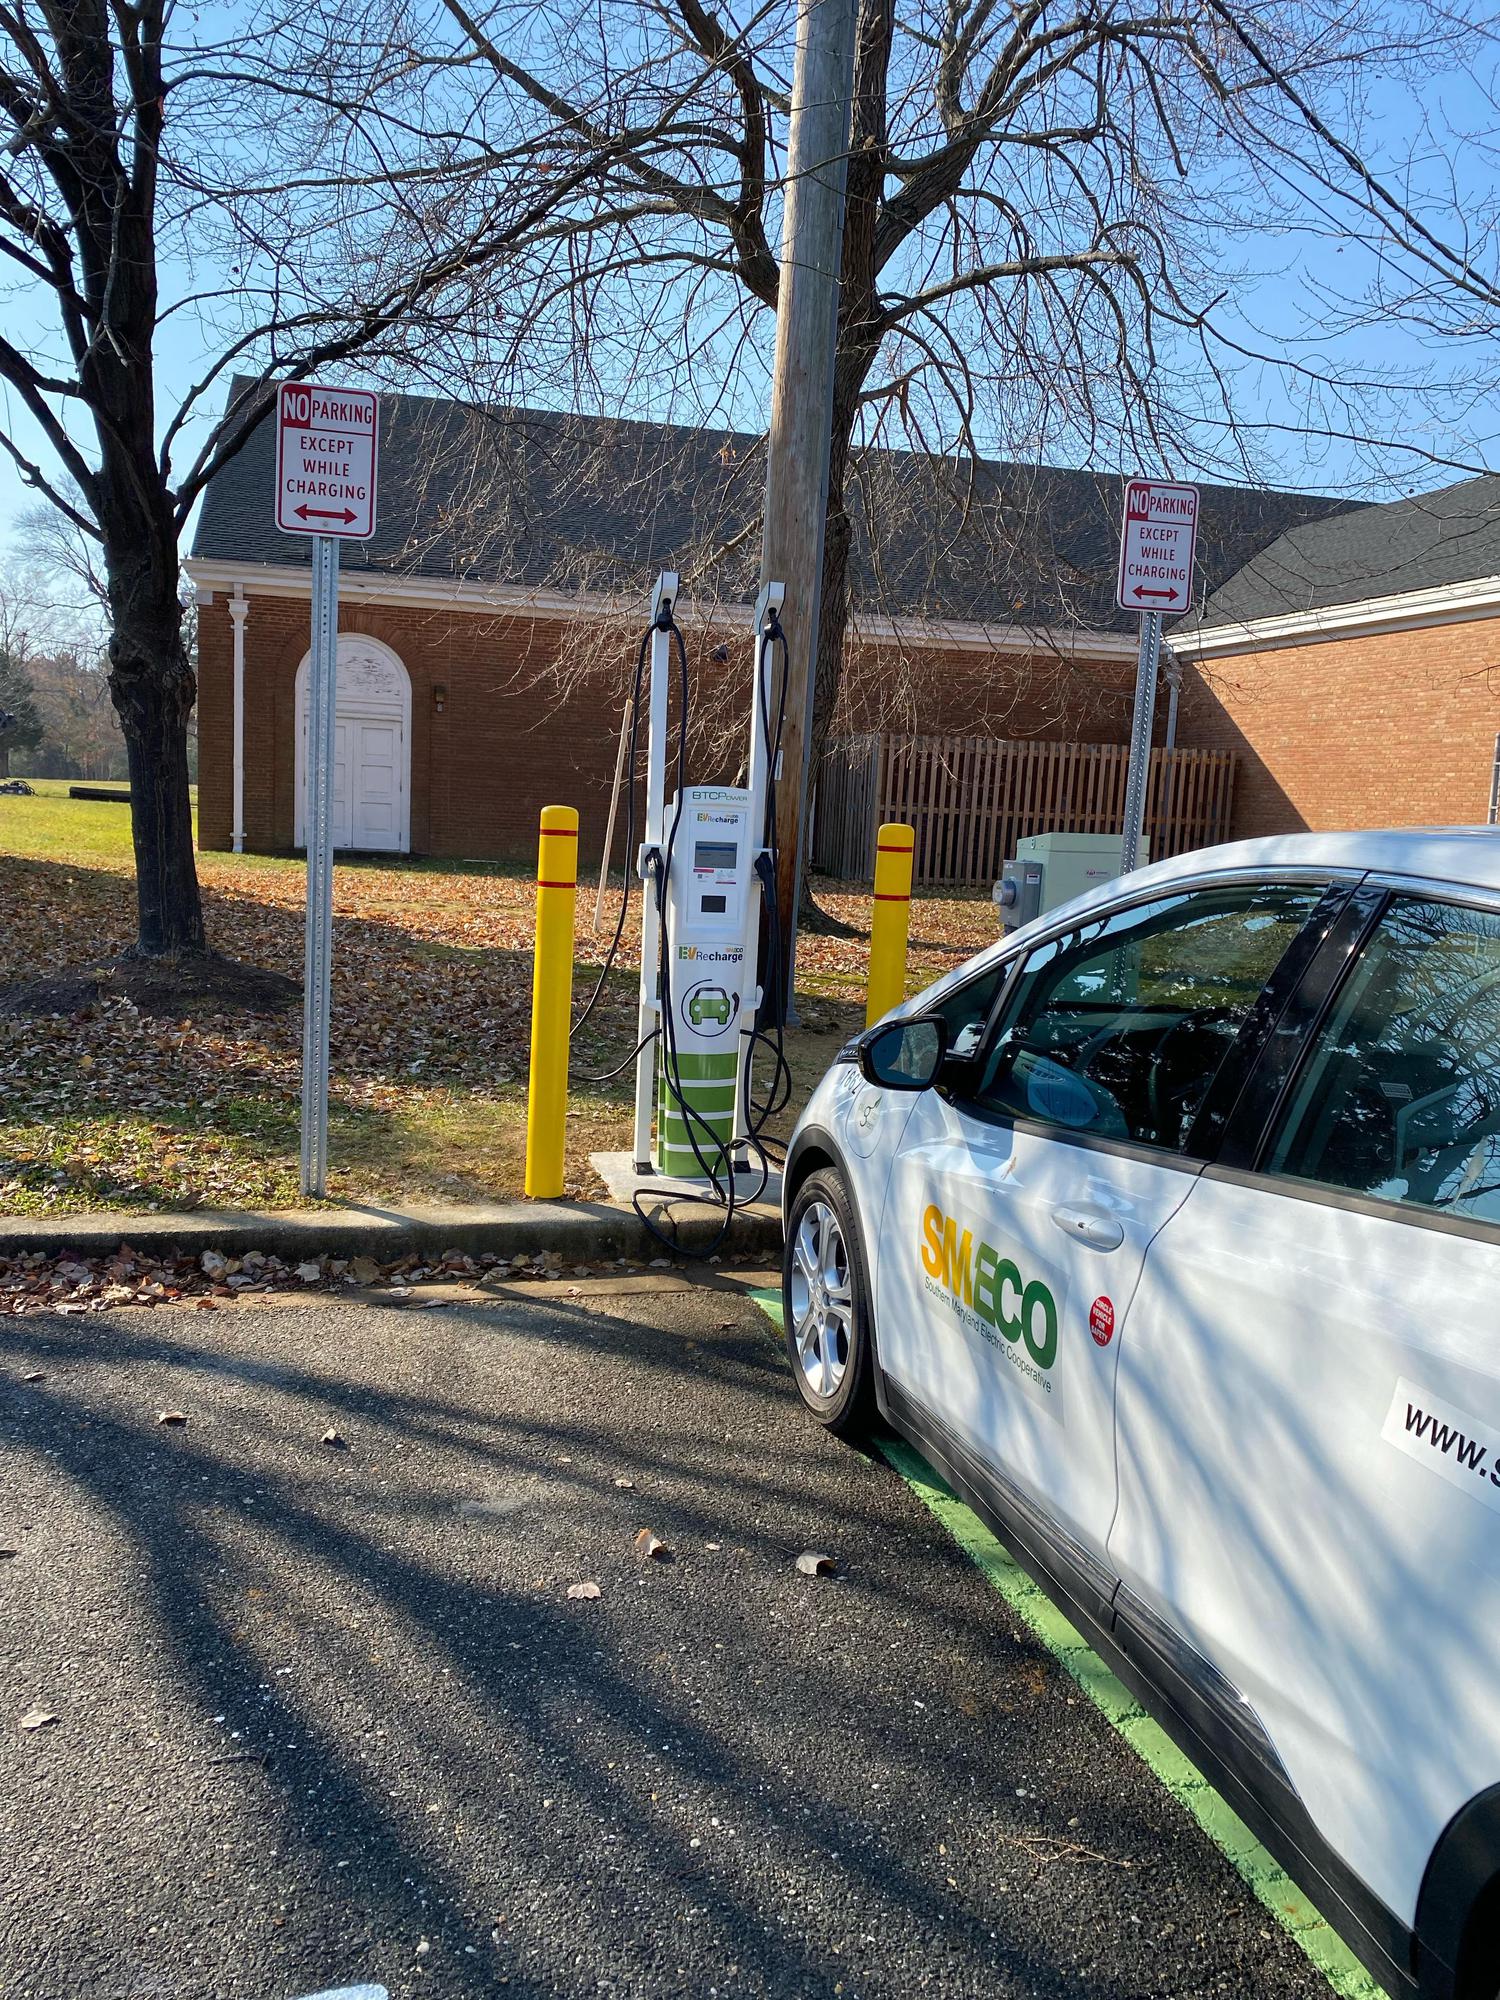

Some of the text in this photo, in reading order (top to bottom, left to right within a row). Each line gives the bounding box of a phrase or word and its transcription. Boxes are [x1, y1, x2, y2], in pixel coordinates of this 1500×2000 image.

[283, 392, 373, 424] NO PARKING
[301, 436, 354, 455] EXCEPT
[303, 458, 350, 477] WHILE
[286, 478, 366, 500] CHARGING
[1129, 489, 1194, 516] NO PARKING
[1140, 527, 1179, 542] EXCEPT
[1141, 546, 1175, 561] WHILE
[1128, 563, 1186, 580] CHARGING
[921, 1204, 1058, 1370] SMECO
[1092, 1306, 1112, 1326] VEHICLE
[1095, 1299, 1112, 1316] CIRCLE
[1091, 1325, 1108, 1342] SAFETY
[1096, 1318, 1106, 1331] FOR
[924, 1276, 1052, 1393] Southern Maryland Electric Cooperative
